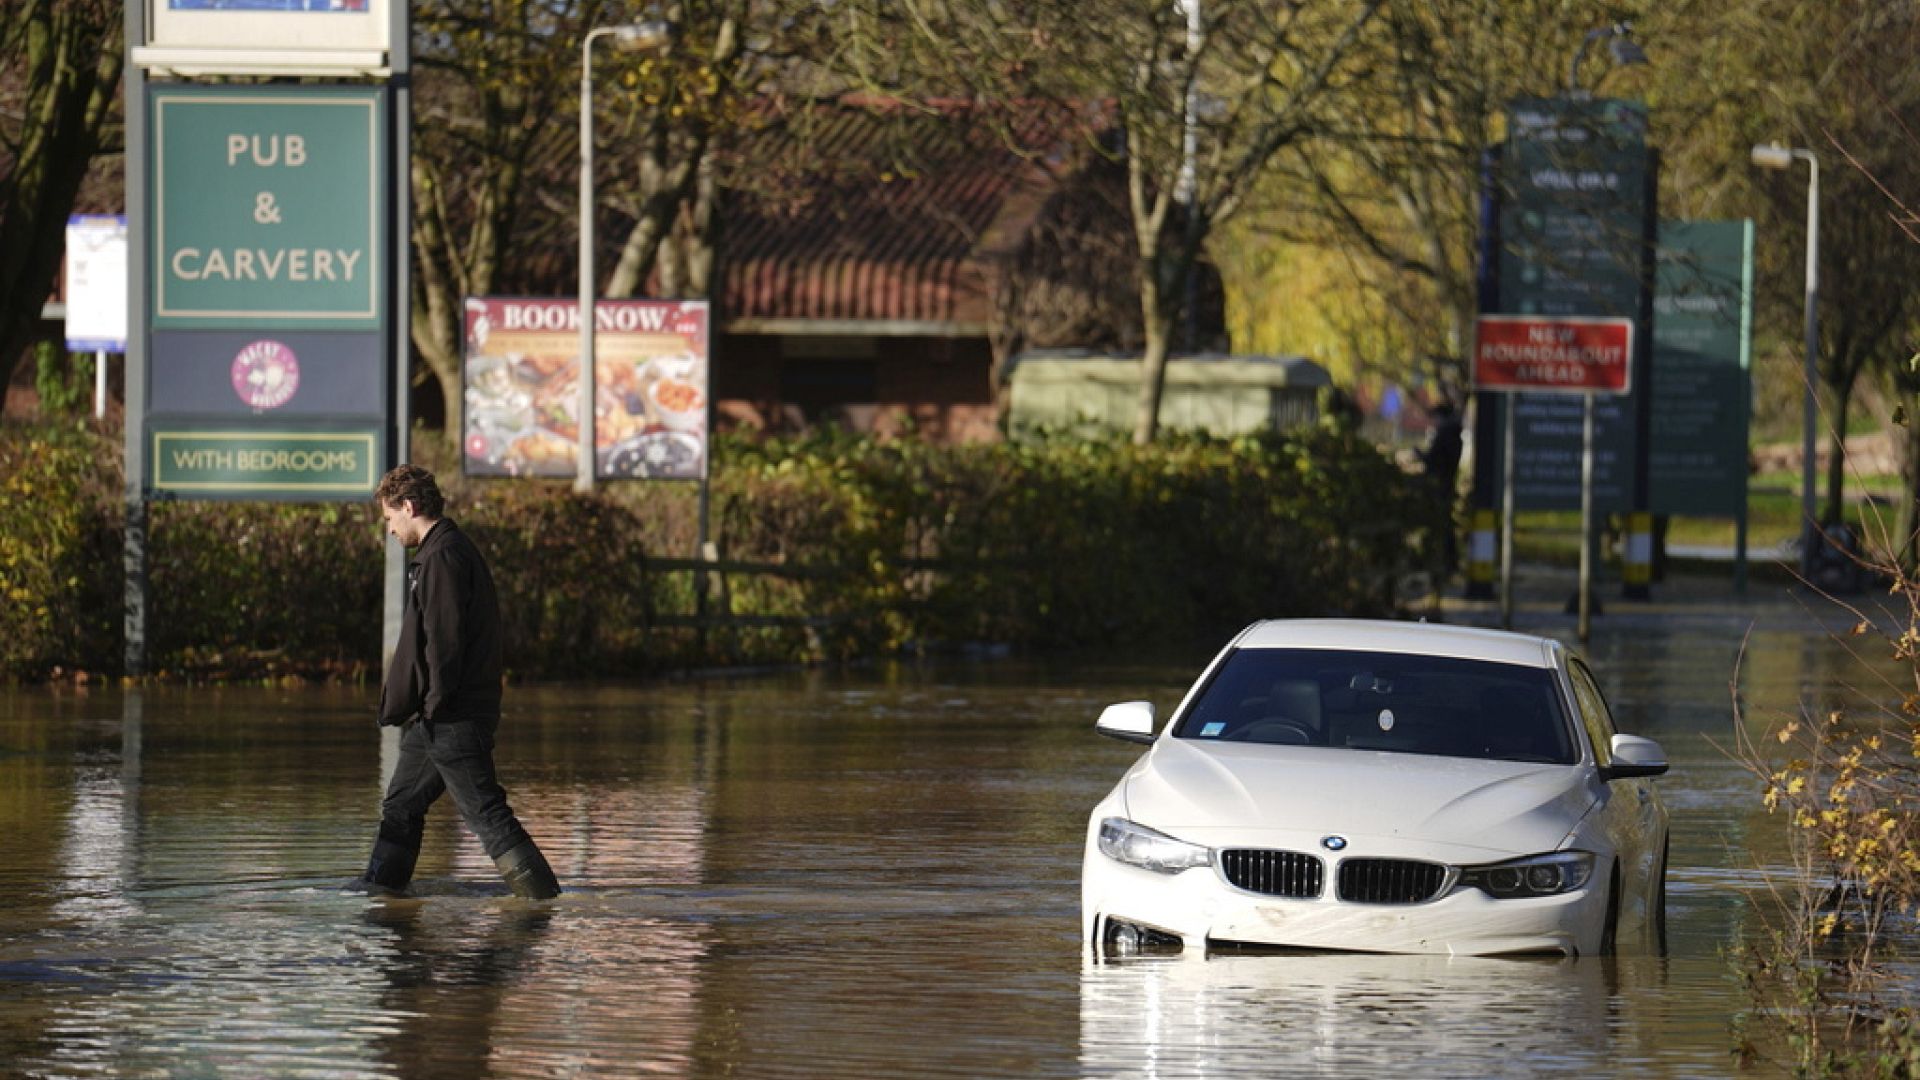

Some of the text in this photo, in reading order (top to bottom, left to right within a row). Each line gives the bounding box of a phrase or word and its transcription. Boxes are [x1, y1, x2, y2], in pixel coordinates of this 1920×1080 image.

[227, 133, 307, 167] PUB
[254, 190, 282, 224] &
[171, 247, 362, 281] CARVERY
[594, 305, 668, 332] NOW
[1528, 325, 1576, 342] NEW
[1481, 343, 1622, 364] ROUNDABOUT
[1515, 363, 1586, 382] AHEAD
[173, 449, 358, 472] WITH BEDROOMS
